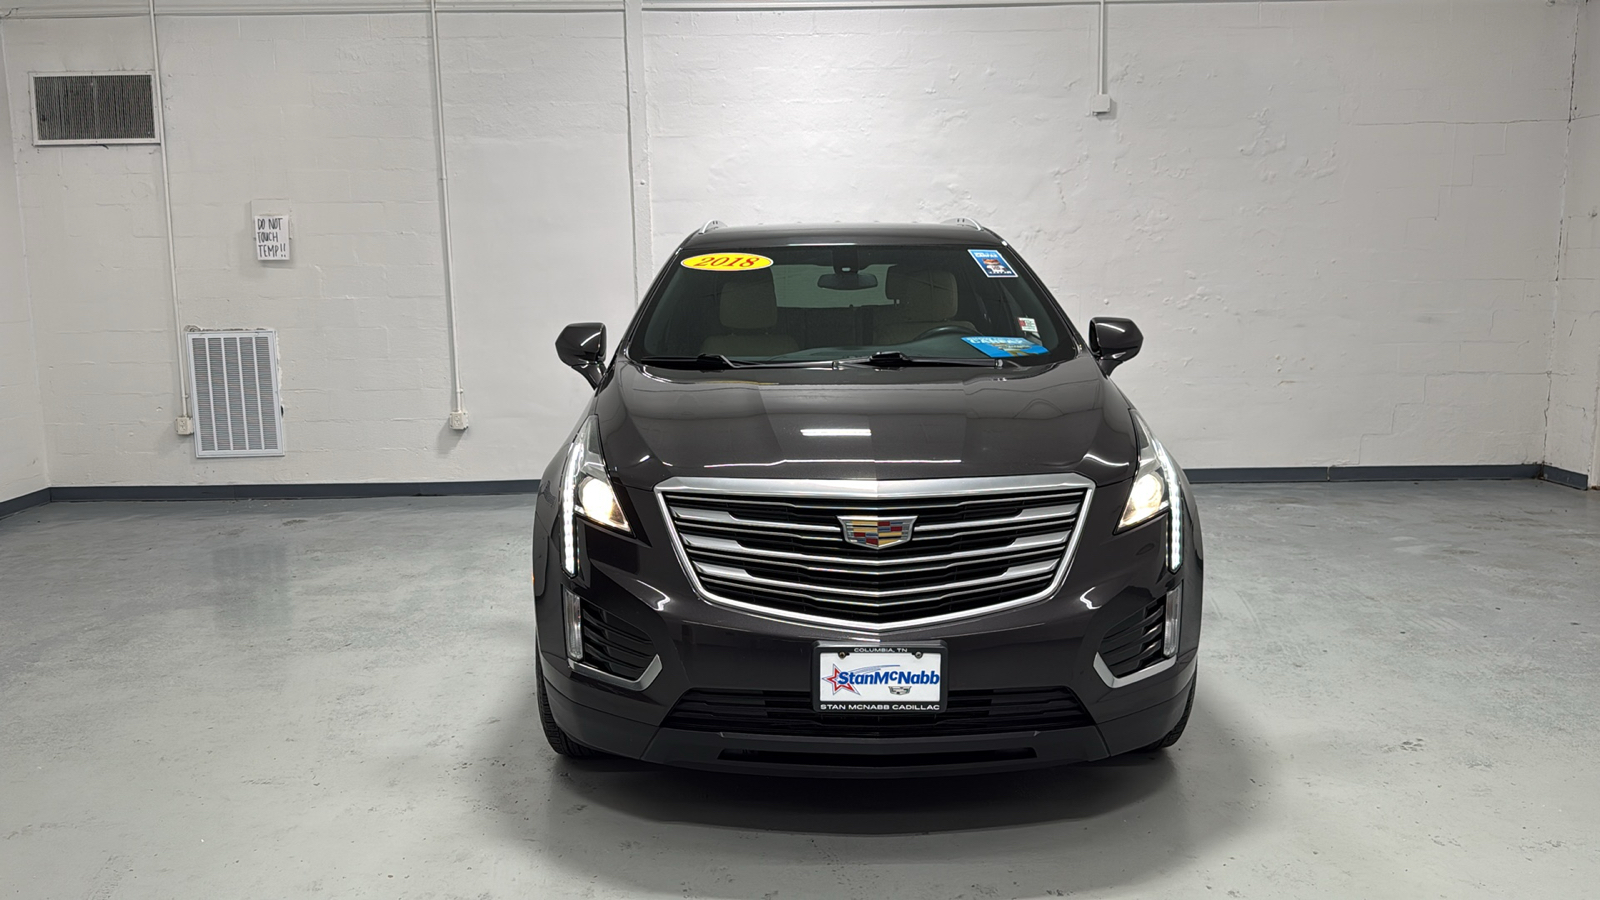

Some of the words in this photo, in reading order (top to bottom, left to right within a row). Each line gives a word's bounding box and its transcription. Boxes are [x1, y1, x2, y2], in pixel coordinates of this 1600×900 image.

[257, 218, 266, 230] DO
[268, 217, 283, 230] NOT
[257, 231, 279, 243] TOUCH
[257, 243, 287, 258] TEMP!!
[692, 256, 760, 268] 2018
[837, 670, 940, 685] StanMcNabb
